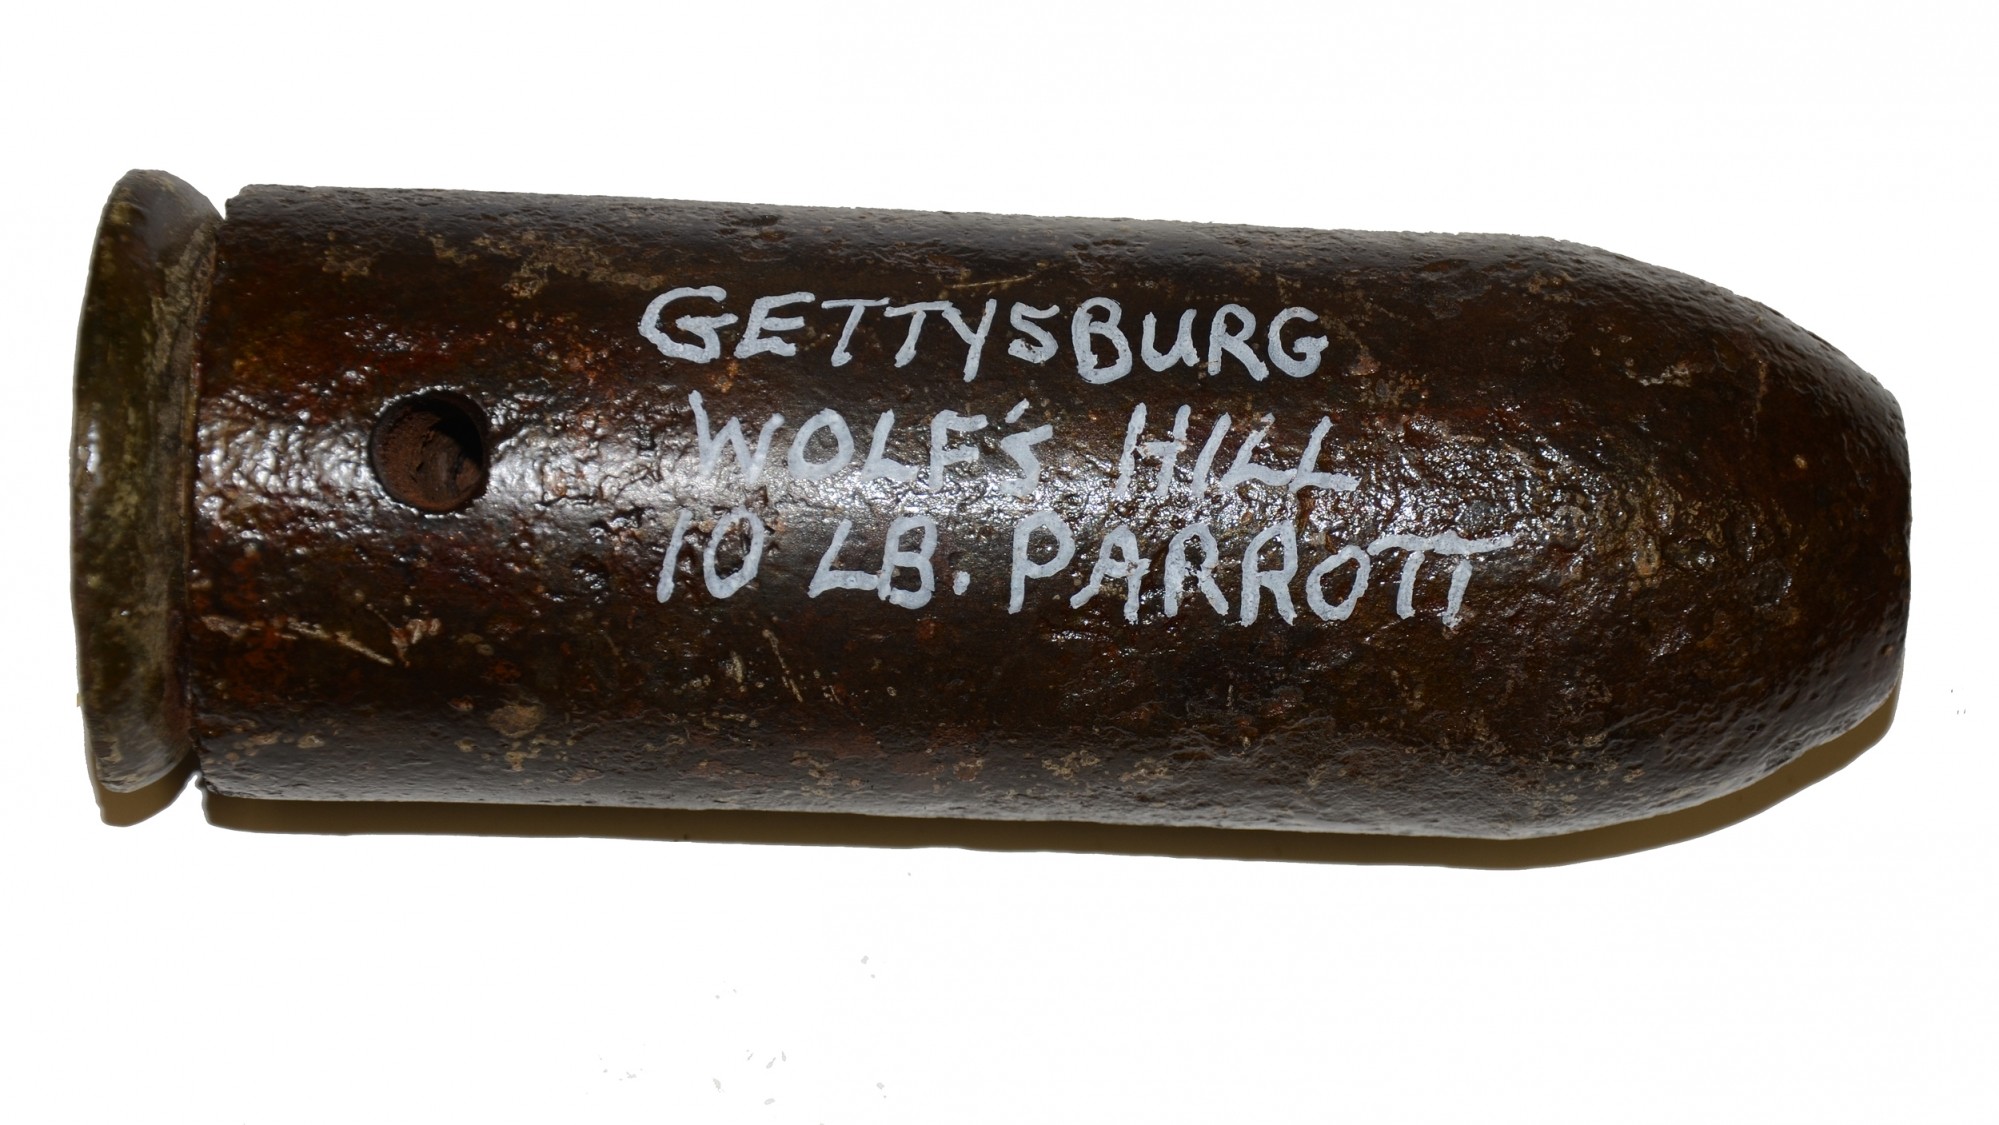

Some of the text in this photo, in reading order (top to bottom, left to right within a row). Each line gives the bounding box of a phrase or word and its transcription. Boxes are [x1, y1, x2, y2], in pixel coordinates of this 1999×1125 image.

[639, 285, 1329, 384] GETTYSBURG
[689, 390, 1361, 498] WOLF'S HILL
[657, 507, 1514, 628] 10 LB. PARROTT
